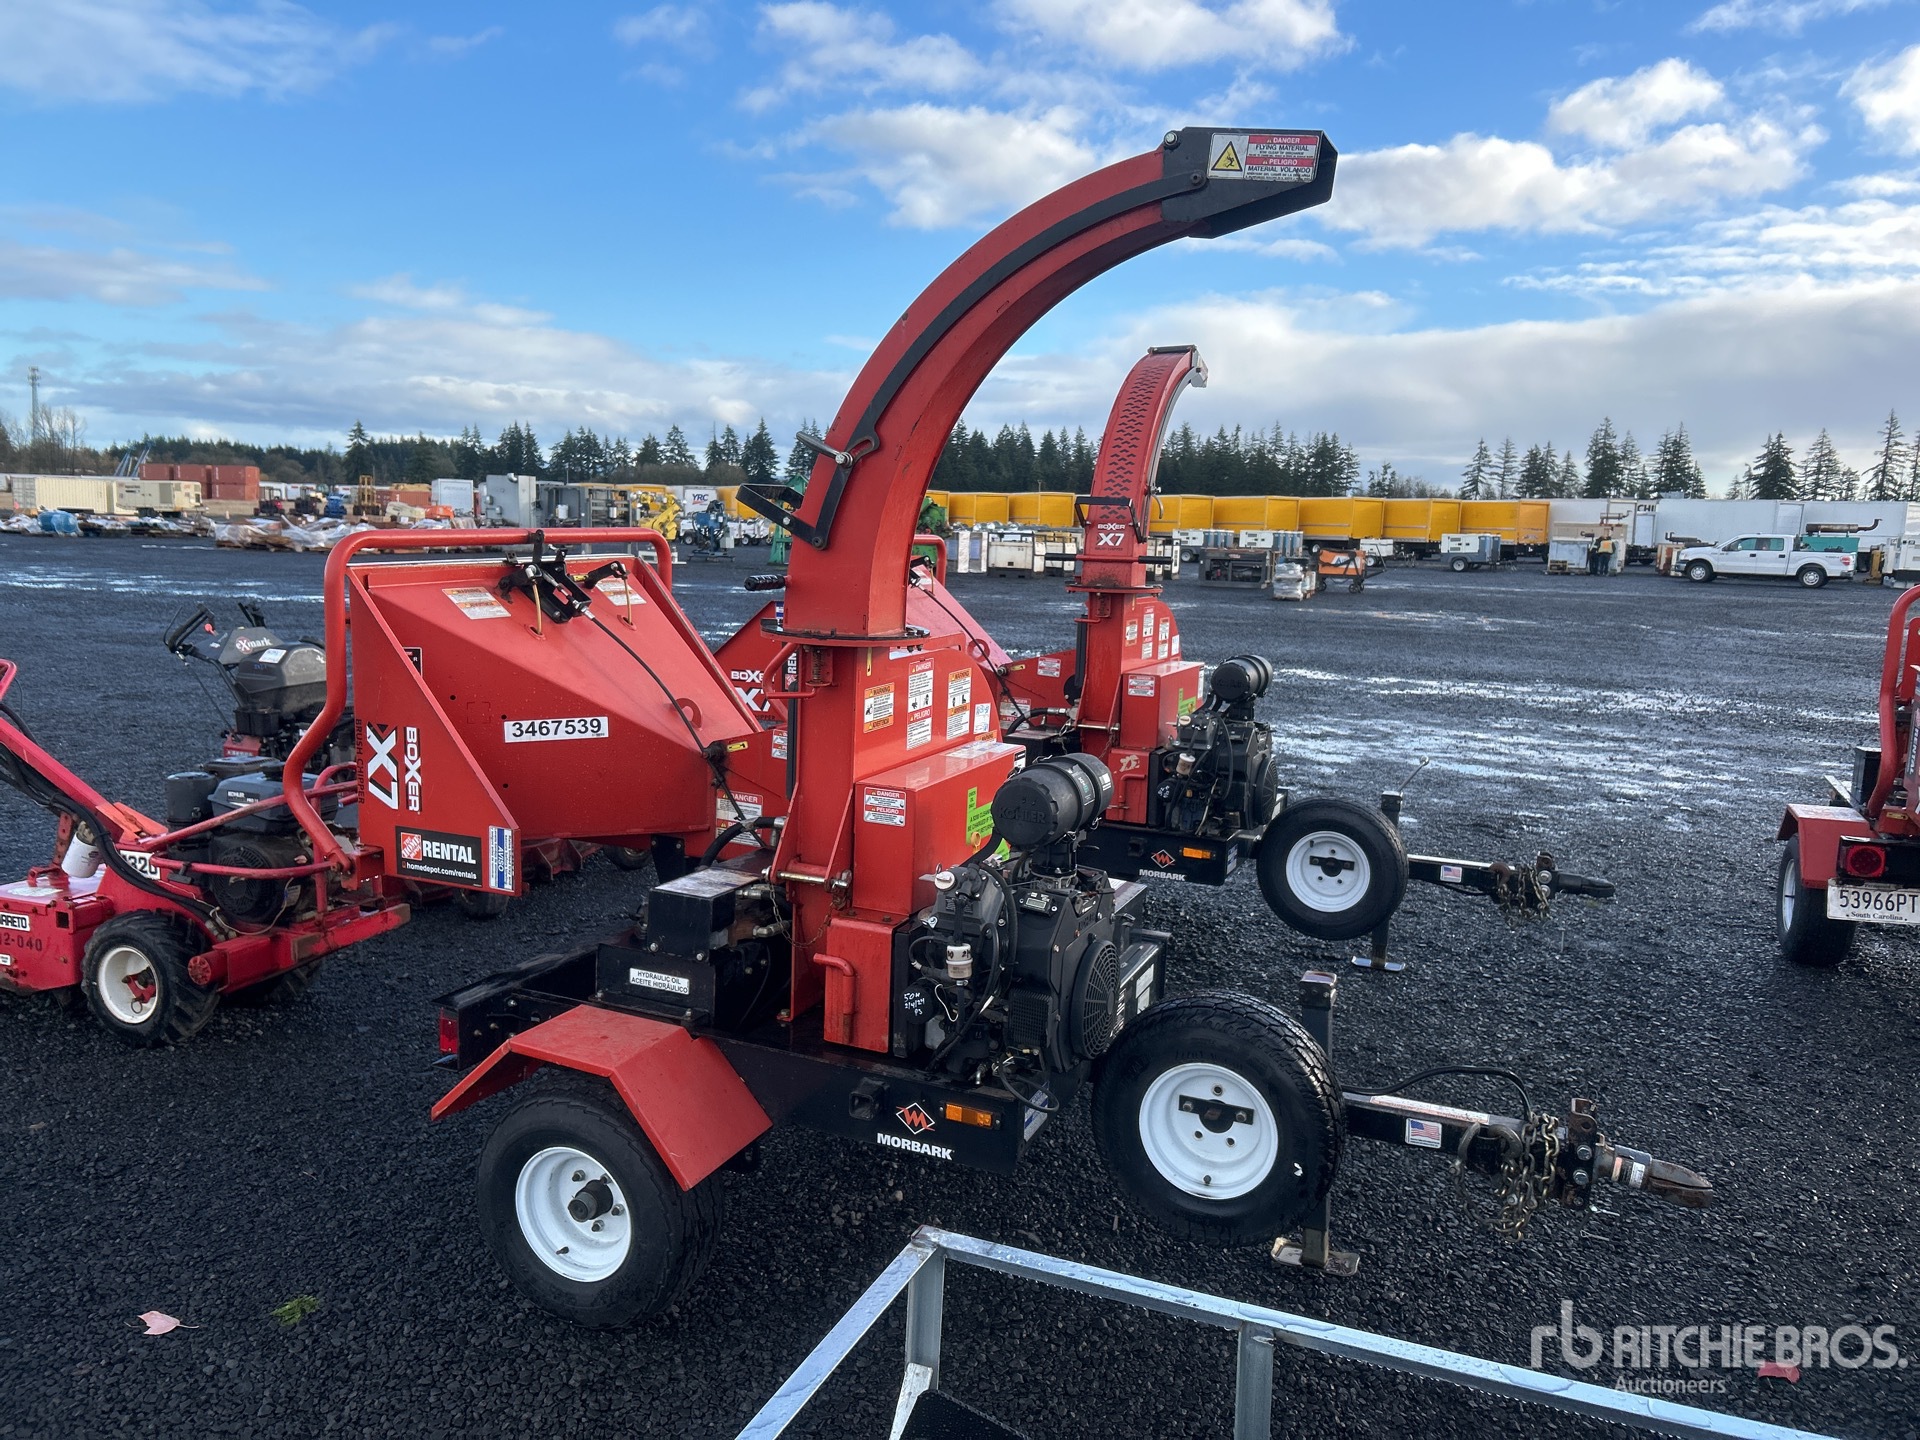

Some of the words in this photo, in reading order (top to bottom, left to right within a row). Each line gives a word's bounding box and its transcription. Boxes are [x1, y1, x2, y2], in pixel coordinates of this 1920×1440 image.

[1279, 144, 1309, 152] MATERIAL
[1280, 166, 1311, 174] VOLANDO
[692, 493, 709, 502] YRC
[1097, 522, 1126, 531] BOXER
[1097, 532, 1125, 547] X7
[787, 652, 797, 674] REN
[915, 661, 932, 672] DANGER
[730, 669, 765, 684] BOXE
[913, 709, 931, 721] PELIGRO
[511, 718, 602, 738] 3467539
[355, 718, 363, 755] BRUSH
[366, 721, 399, 810] X7
[403, 725, 423, 813] BOXER
[357, 758, 365, 804] CHIPPER
[876, 790, 900, 798] DANGER
[876, 806, 899, 815] PELIGRO
[1000, 807, 1046, 824] KOHLER
[401, 835, 420, 859] HOME
[422, 839, 477, 865] RENTAL
[406, 861, 477, 880] homedepot.com/rentals
[1138, 868, 1186, 882] MORBARK
[1839, 889, 1919, 914] 53966PT
[1850, 911, 1871, 919] South
[1872, 912, 1904, 921] Carolina
[631, 976, 652, 986] ACEITE
[637, 970, 671, 983] HYDRAULIC
[671, 977, 681, 985] OIL
[876, 1132, 953, 1161] MORBARK
